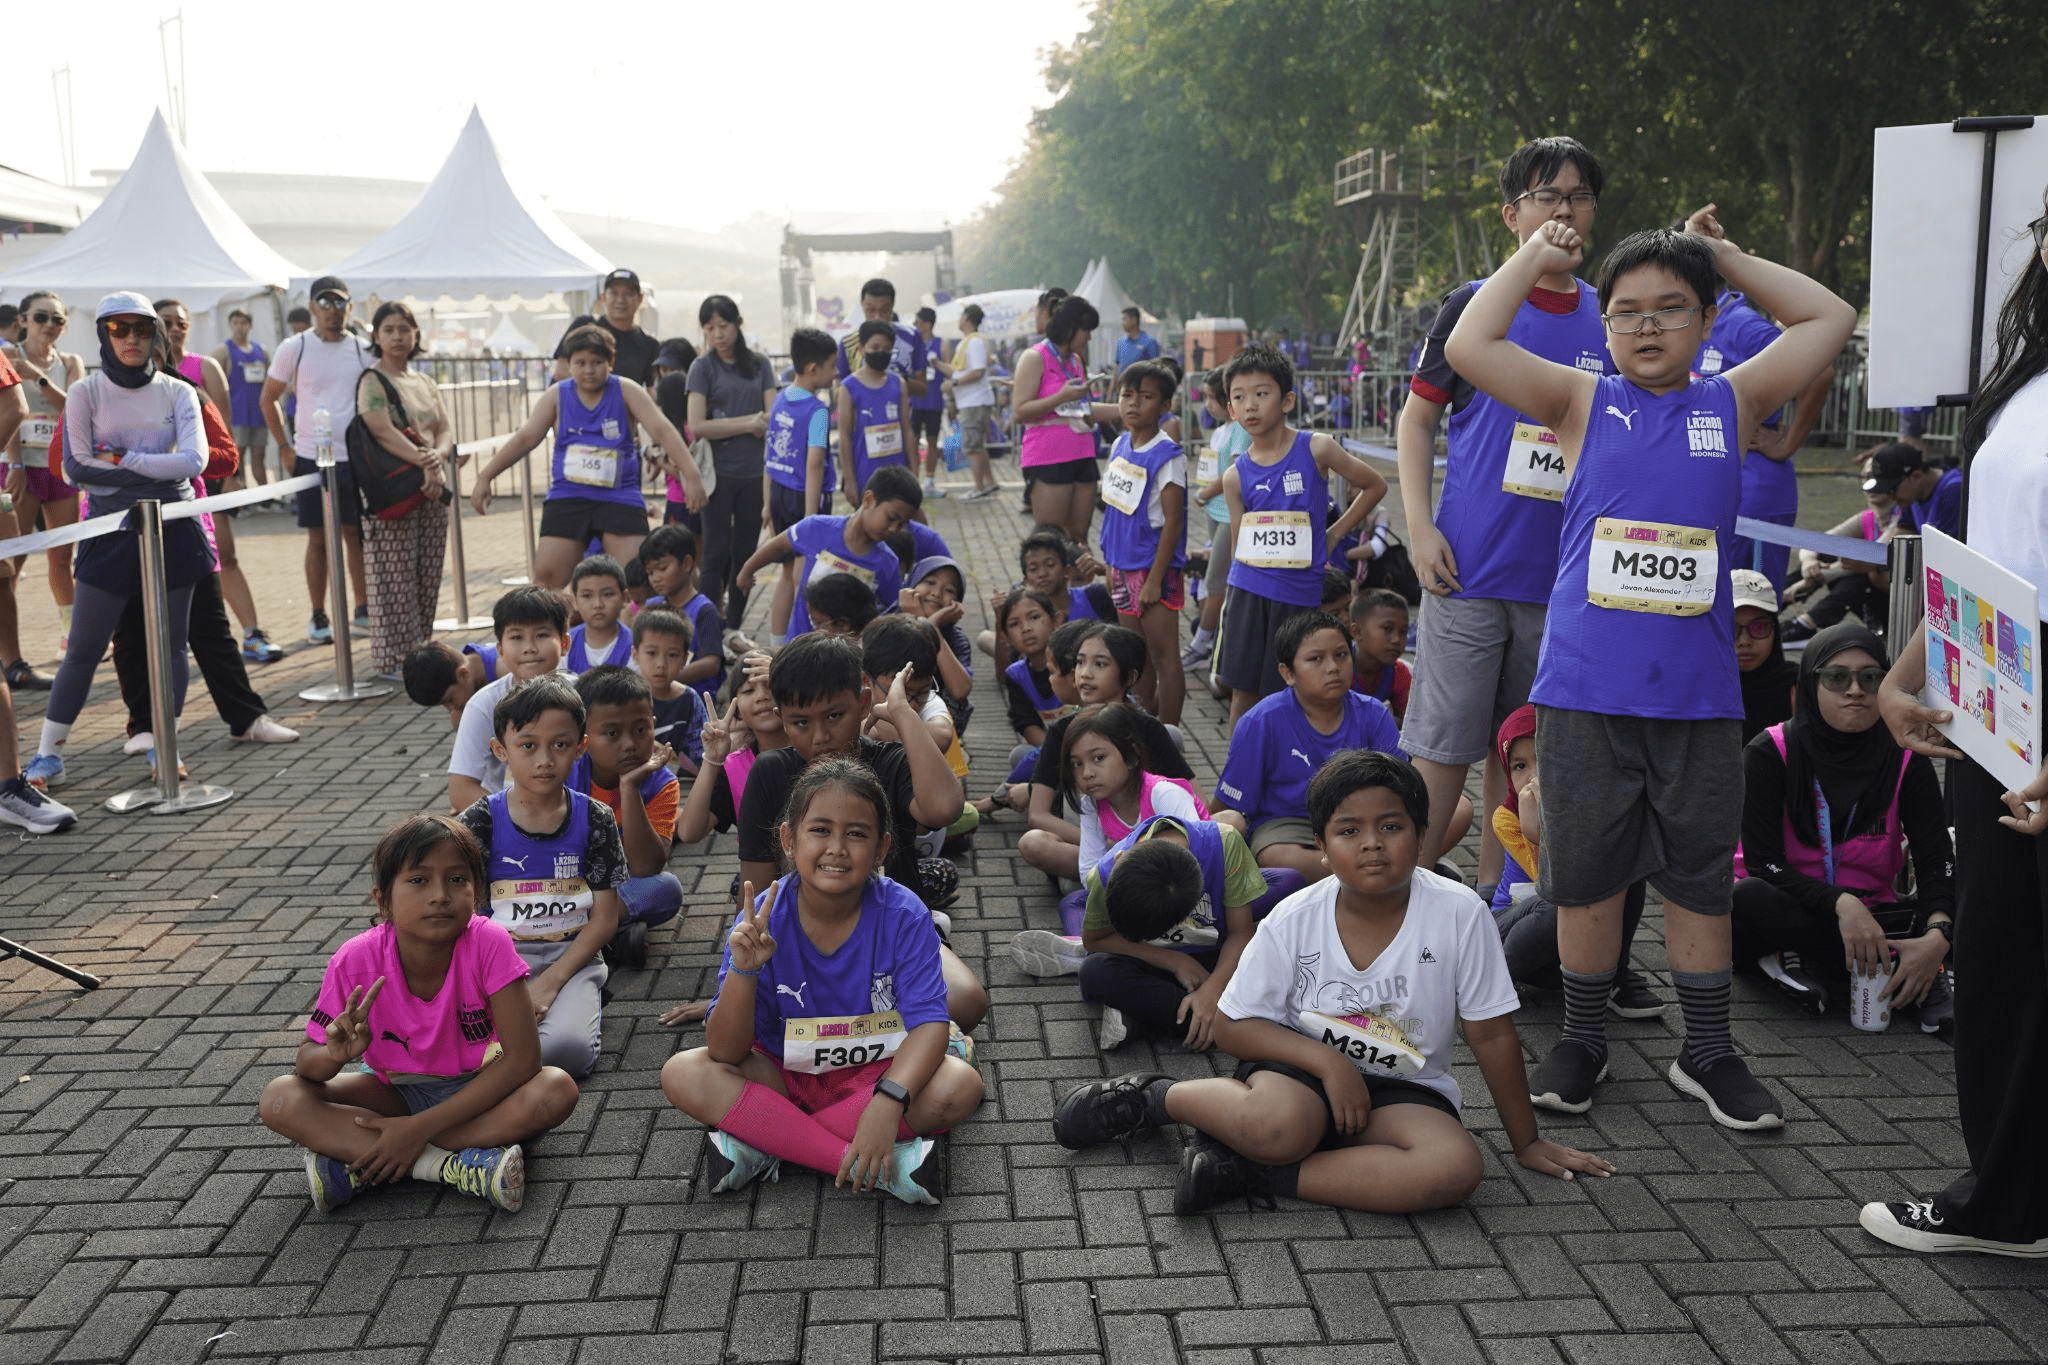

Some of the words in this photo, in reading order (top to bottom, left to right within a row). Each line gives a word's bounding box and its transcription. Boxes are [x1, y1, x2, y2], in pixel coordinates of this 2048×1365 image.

[1575, 356, 1603, 371] LAZADA
[34, 424, 57, 434] F51
[1686, 417, 1723, 430] LAZADA
[1688, 430, 1728, 453] RUN
[1690, 451, 1726, 459] INDONESIA
[1253, 531, 1297, 546] M313
[1689, 538, 1708, 547] KIDS
[1612, 550, 1698, 582] M303
[1620, 584, 1642, 592] Jovan
[1643, 586, 1682, 595] Alexander
[1220, 781, 1243, 801] PUMA
[1341, 975, 1409, 1009] POUR
[795, 1028, 805, 1036] ID
[878, 1020, 898, 1030] KIDS
[814, 1043, 885, 1067] F307
[1321, 1027, 1397, 1069] M314
